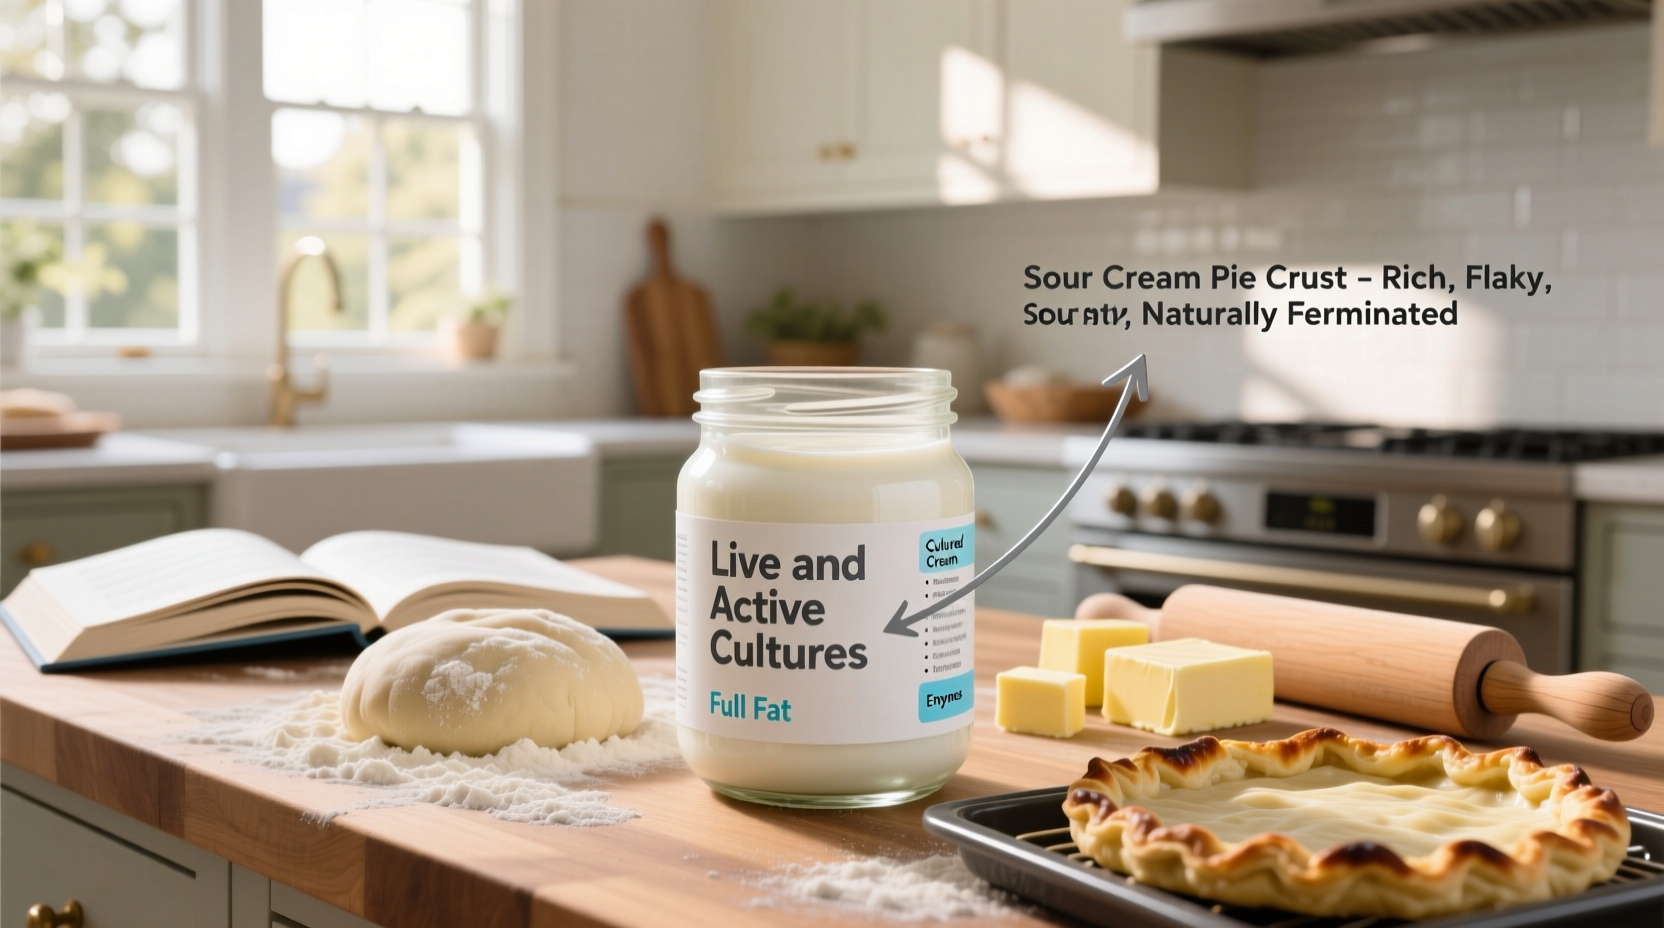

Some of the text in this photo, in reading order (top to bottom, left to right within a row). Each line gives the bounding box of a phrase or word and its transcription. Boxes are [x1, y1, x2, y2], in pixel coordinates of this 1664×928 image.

[711, 540, 866, 581] Live and
[710, 585, 826, 626] Active
[710, 629, 868, 670] Cultures
[710, 691, 792, 722] Full Fat
